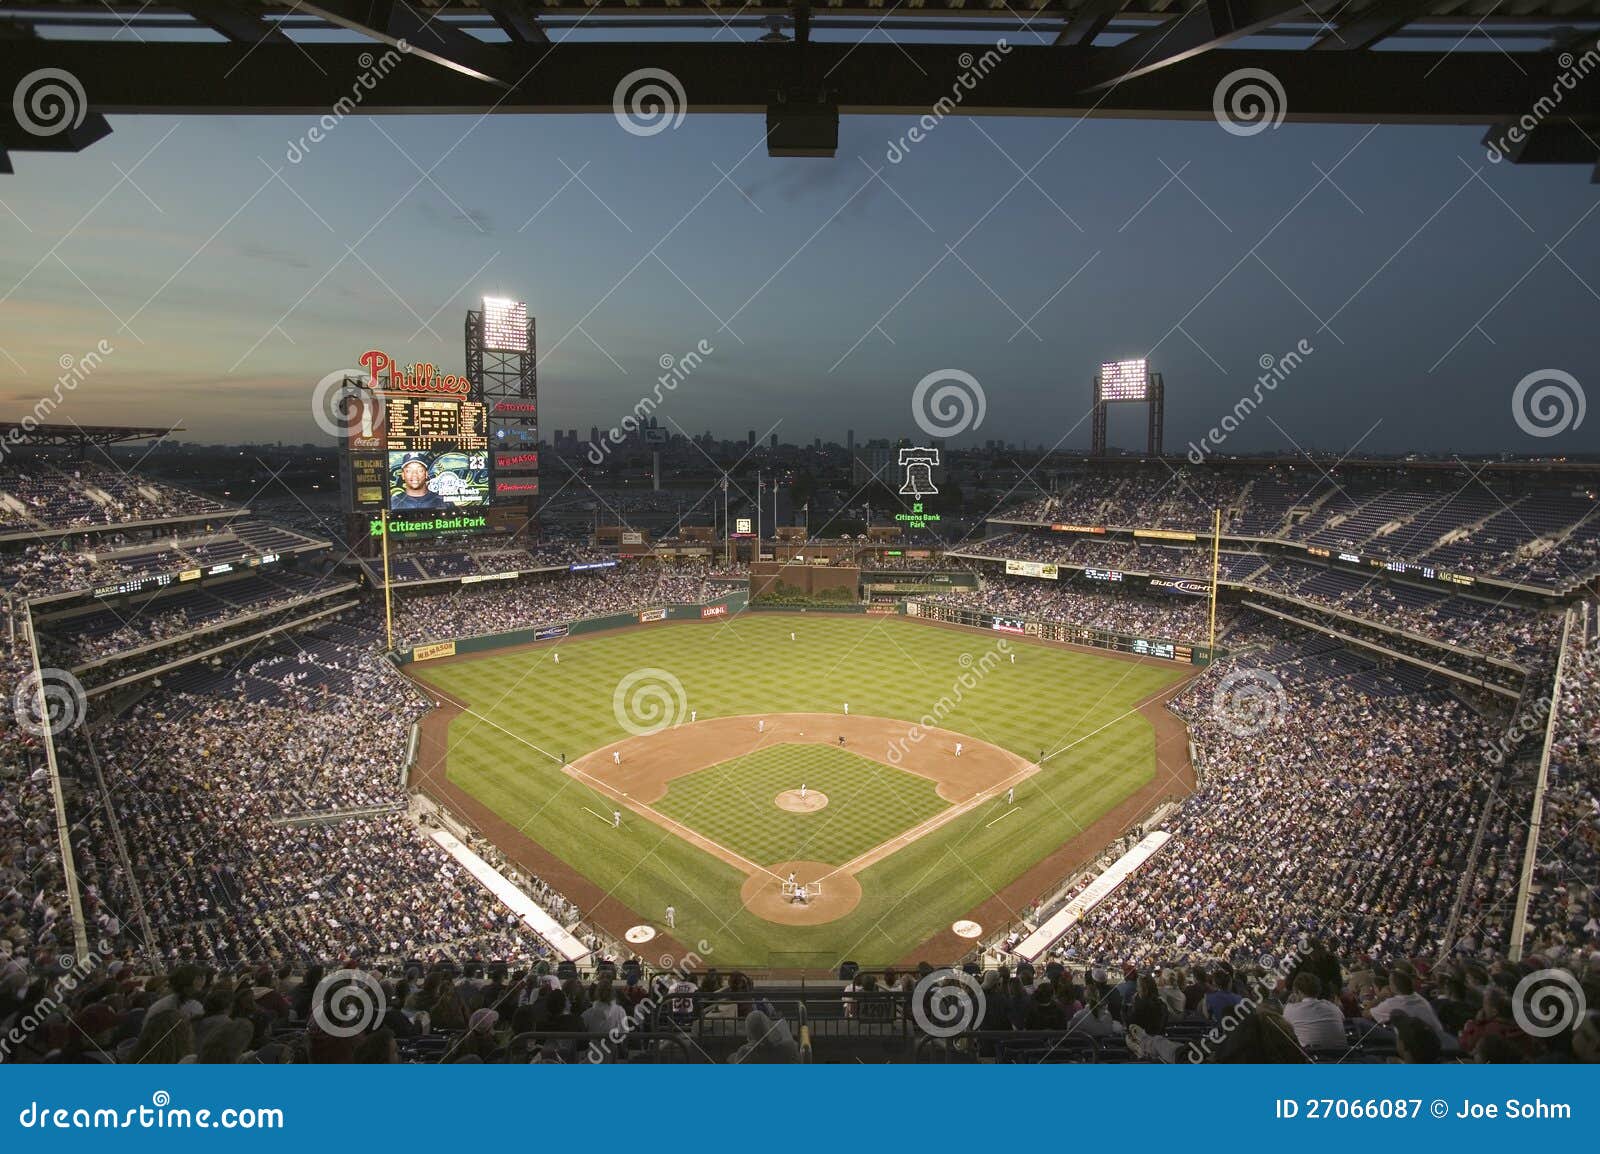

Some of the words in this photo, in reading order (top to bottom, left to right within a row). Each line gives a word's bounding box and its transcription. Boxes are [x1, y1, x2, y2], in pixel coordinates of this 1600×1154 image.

[360, 350, 471, 394] Phillies
[469, 456, 485, 470] 23
[496, 484, 537, 492] Budweiser
[895, 513, 923, 521] Citizens
[923, 513, 941, 521] Bank
[389, 519, 433, 532] Citizens
[435, 517, 461, 529] Bank
[463, 516, 486, 528] Park
[910, 520, 925, 529] Park
[95, 586, 118, 594] MARSH
